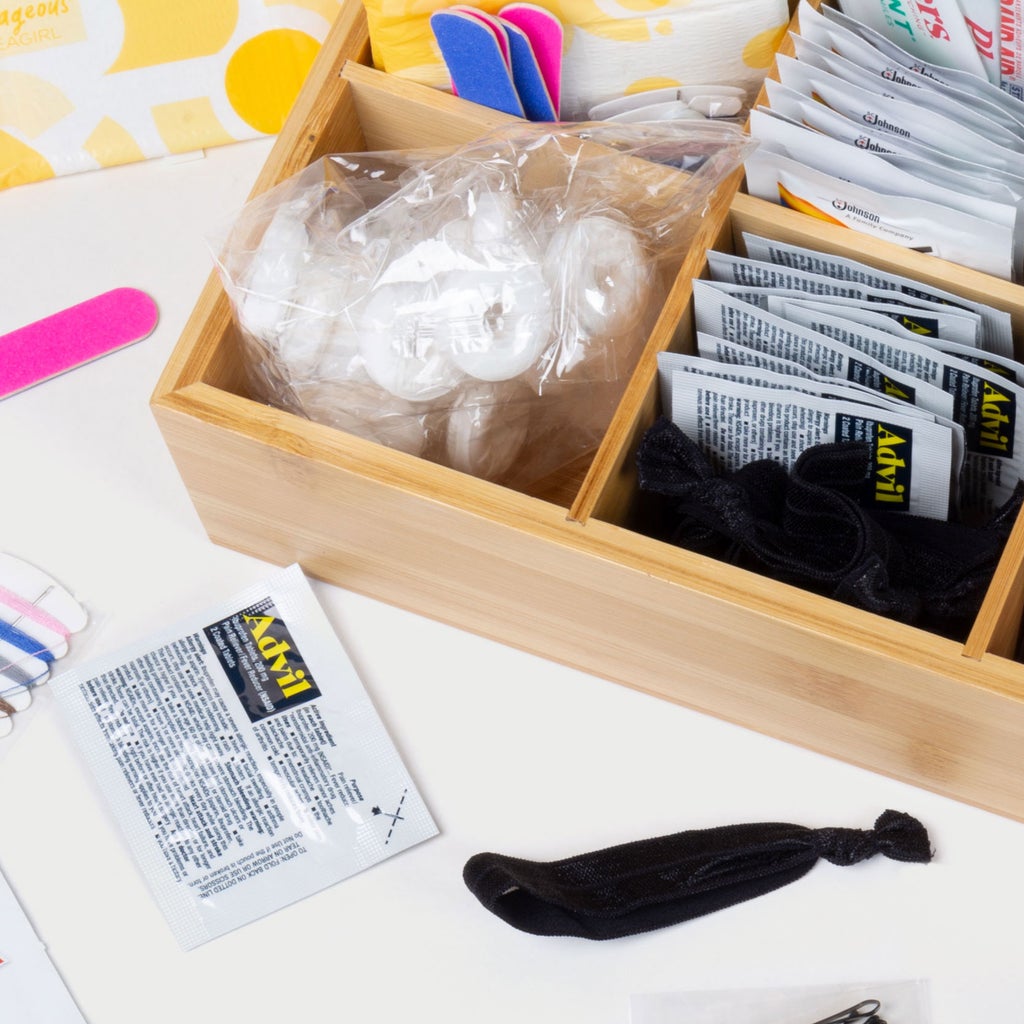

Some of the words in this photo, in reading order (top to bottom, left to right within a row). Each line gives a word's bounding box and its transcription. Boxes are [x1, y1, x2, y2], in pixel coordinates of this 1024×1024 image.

[863, 114, 911, 138] Johnson
[832, 200, 881, 224] Johnson
[979, 380, 1011, 454] Advil
[874, 423, 907, 503] Advil
[244, 615, 311, 699] Advil
